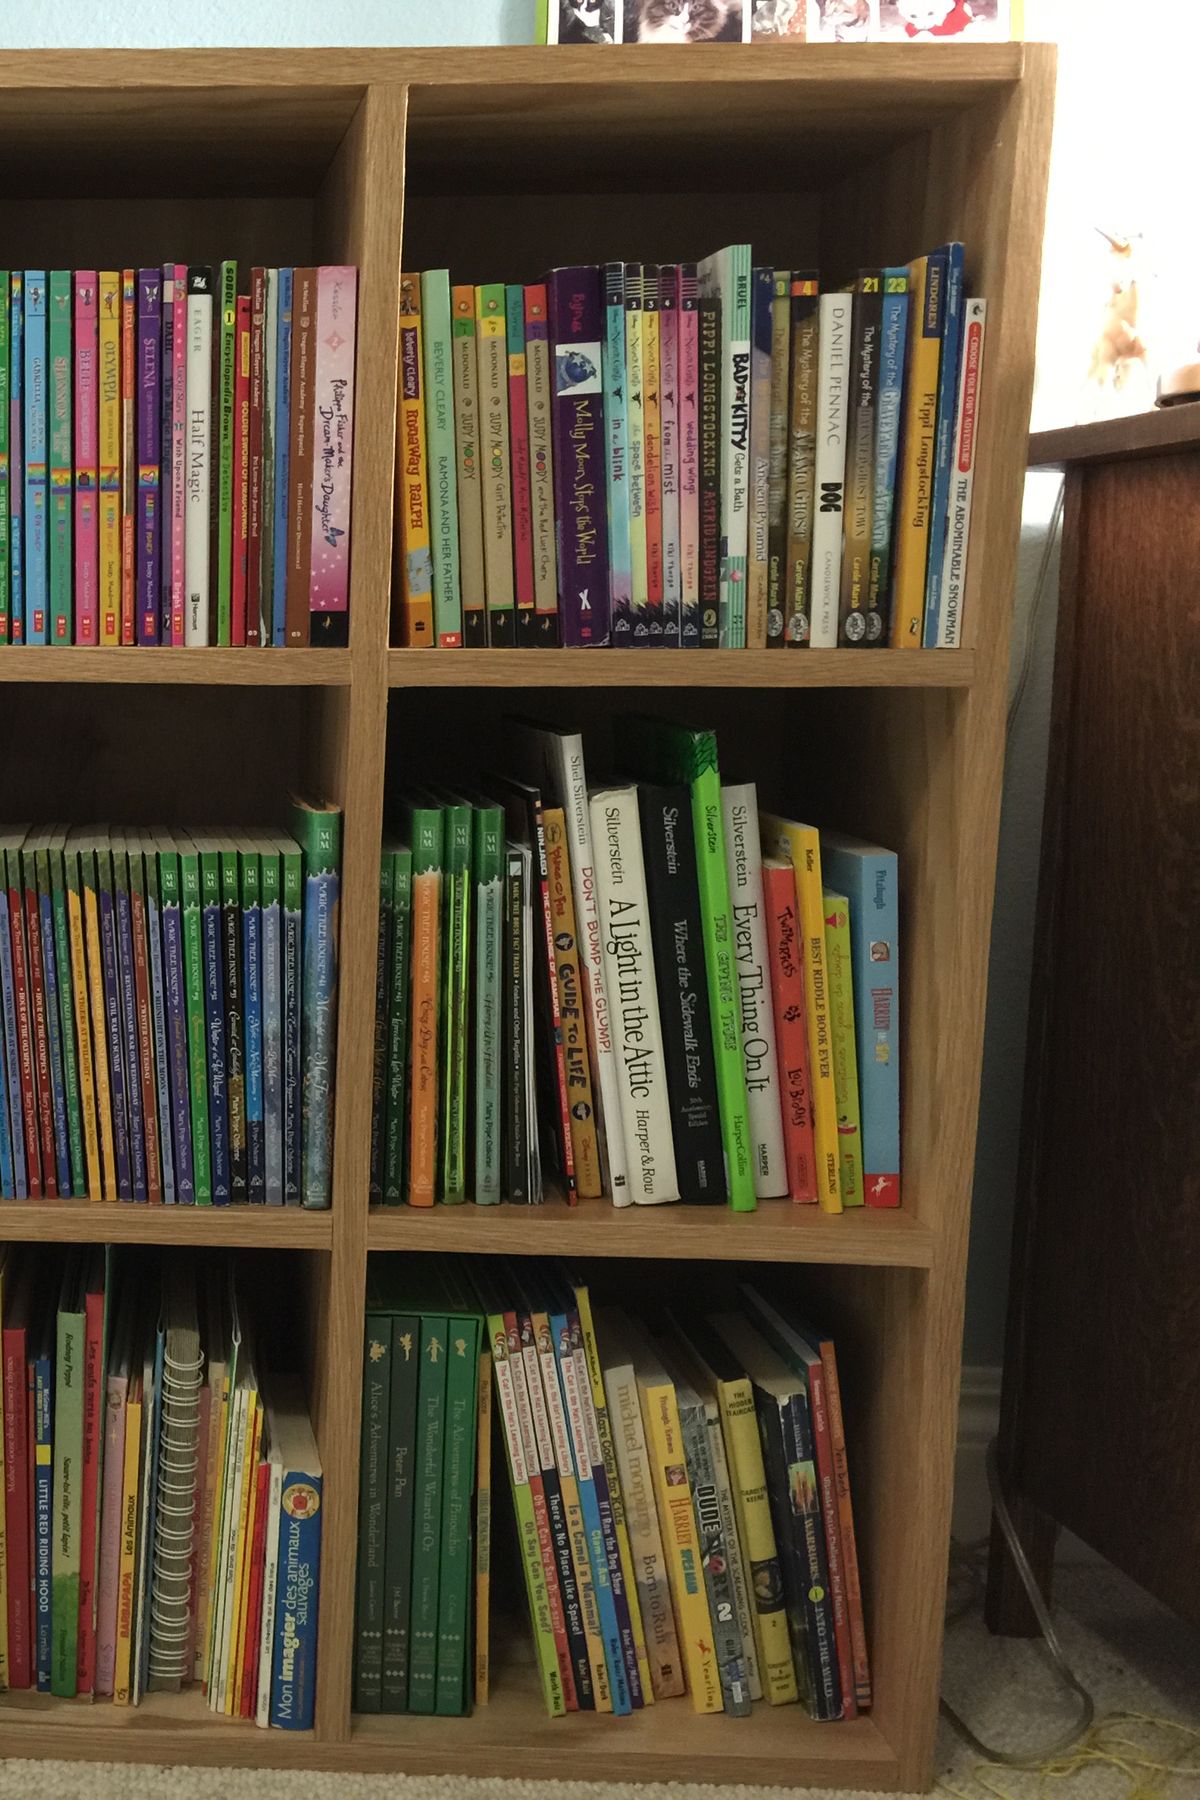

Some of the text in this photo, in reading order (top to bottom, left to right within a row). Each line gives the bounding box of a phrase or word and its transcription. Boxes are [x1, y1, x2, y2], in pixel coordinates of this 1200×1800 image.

[224, 267, 233, 305] SOBOL
[738, 276, 747, 309] BRUEL
[928, 267, 939, 329] LINDGREN
[143, 338, 155, 388] SELENA
[193, 309, 202, 352] EAGER
[103, 341, 116, 402] OLYMPIA
[433, 341, 446, 430] BEVERLY CLEARY
[703, 312, 717, 477] PIPPI LONGSTOCKING
[733, 354, 749, 384] BAD
[827, 308, 844, 445] DANIEL PENNAC
[189, 410, 205, 502] Half Magic
[732, 403, 749, 450] KITTY
[913, 392, 935, 527] Pippi Longstocking
[570, 400, 595, 565] Molly Moon Stops the World
[734, 453, 744, 474] Gets
[820, 483, 842, 512] DOG
[438, 456, 454, 603] RAMONA AND HER FATHER
[733, 488, 744, 512] Bath
[945, 479, 968, 645] THE ABOMINABLE SNOWMAN
[604, 807, 627, 886] Silverstein
[663, 806, 681, 874] Silverstein
[731, 806, 749, 887] Silverstein
[806, 849, 814, 872] Keller
[874, 870, 888, 909] Fitzhugh
[608, 899, 653, 1099] A Light in the Attic
[673, 919, 700, 1088] Where the Sidewalk Ends
[732, 904, 771, 1094] Every Thing On It
[811, 937, 829, 1078] BEST RIDDLE BOOK EVER
[871, 988, 893, 1031] HARRIET
[112, 1034, 119, 1044] ON
[113, 1046, 121, 1073] SUNDAY
[634, 1109, 656, 1194] Harper & Row
[827, 1153, 837, 1194] STERLING
[597, 1407, 625, 1525] More Codes for Kids
[696, 1485, 721, 1532] DUDE
[38, 1479, 48, 1612] LITTLE RED RIDING HOOD
[278, 1522, 300, 1718] Mon imagier des animaux
[297, 1563, 312, 1625] sauvages
[642, 1555, 667, 1645] Born to Run
